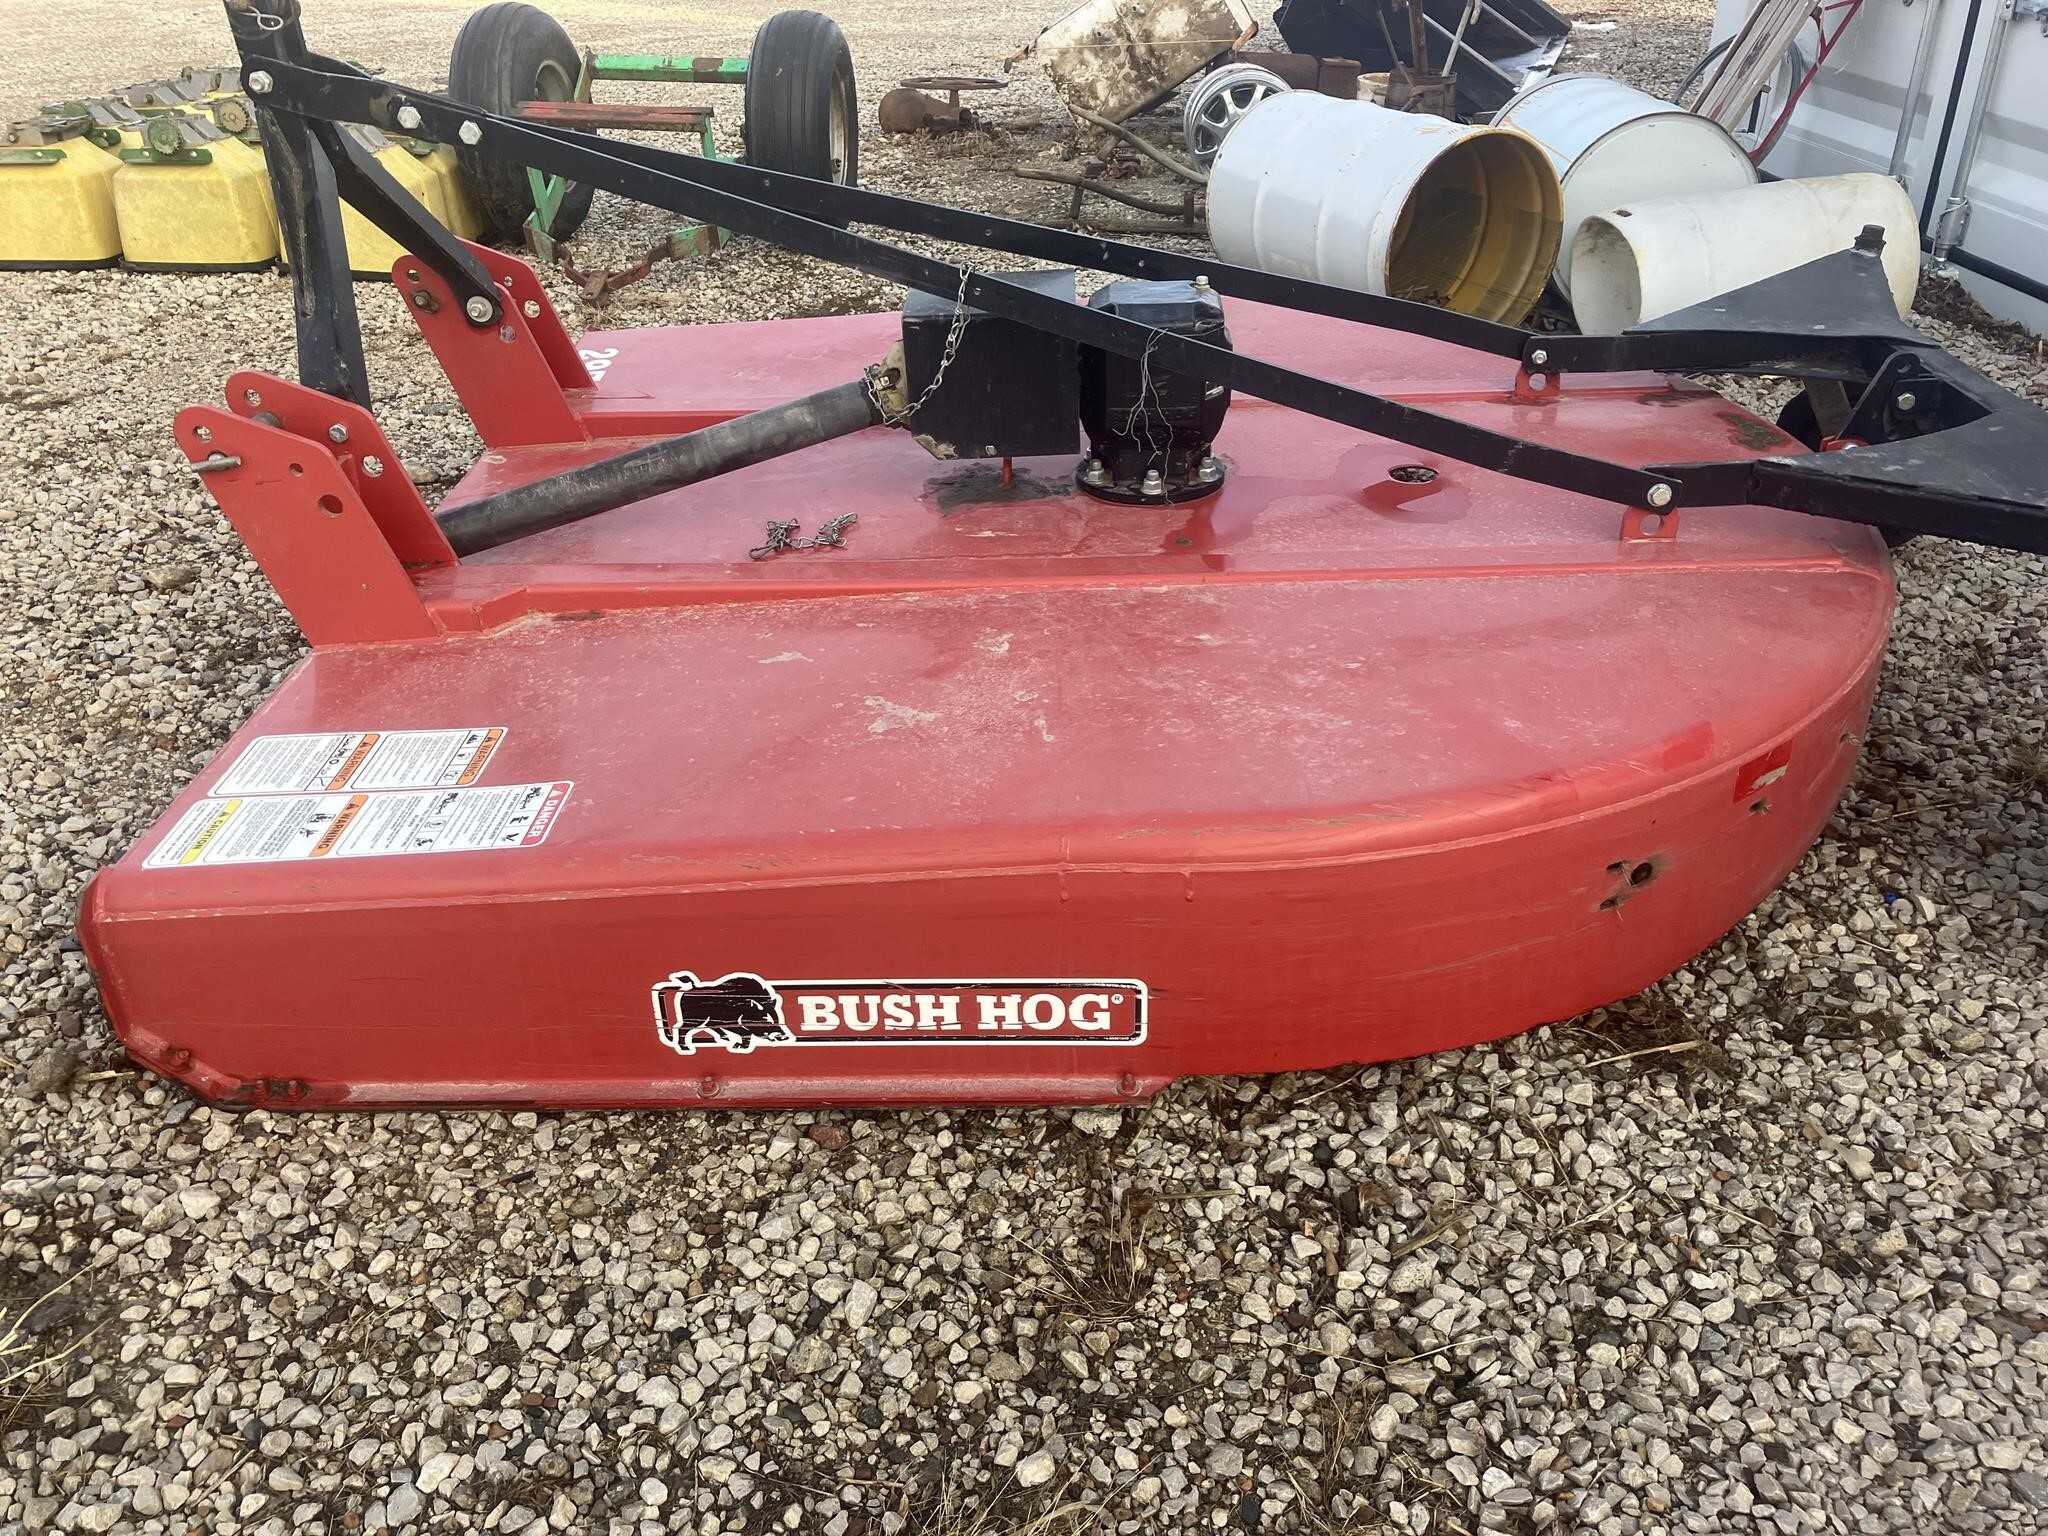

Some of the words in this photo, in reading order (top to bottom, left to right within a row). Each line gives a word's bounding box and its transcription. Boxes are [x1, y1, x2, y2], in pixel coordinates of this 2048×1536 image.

[334, 749, 367, 782] WARNING
[463, 744, 492, 776] WARNING
[192, 819, 223, 850] CAUTION
[317, 812, 352, 849] WARNING
[527, 799, 558, 838] DANGER
[797, 994, 962, 1031] BUSH
